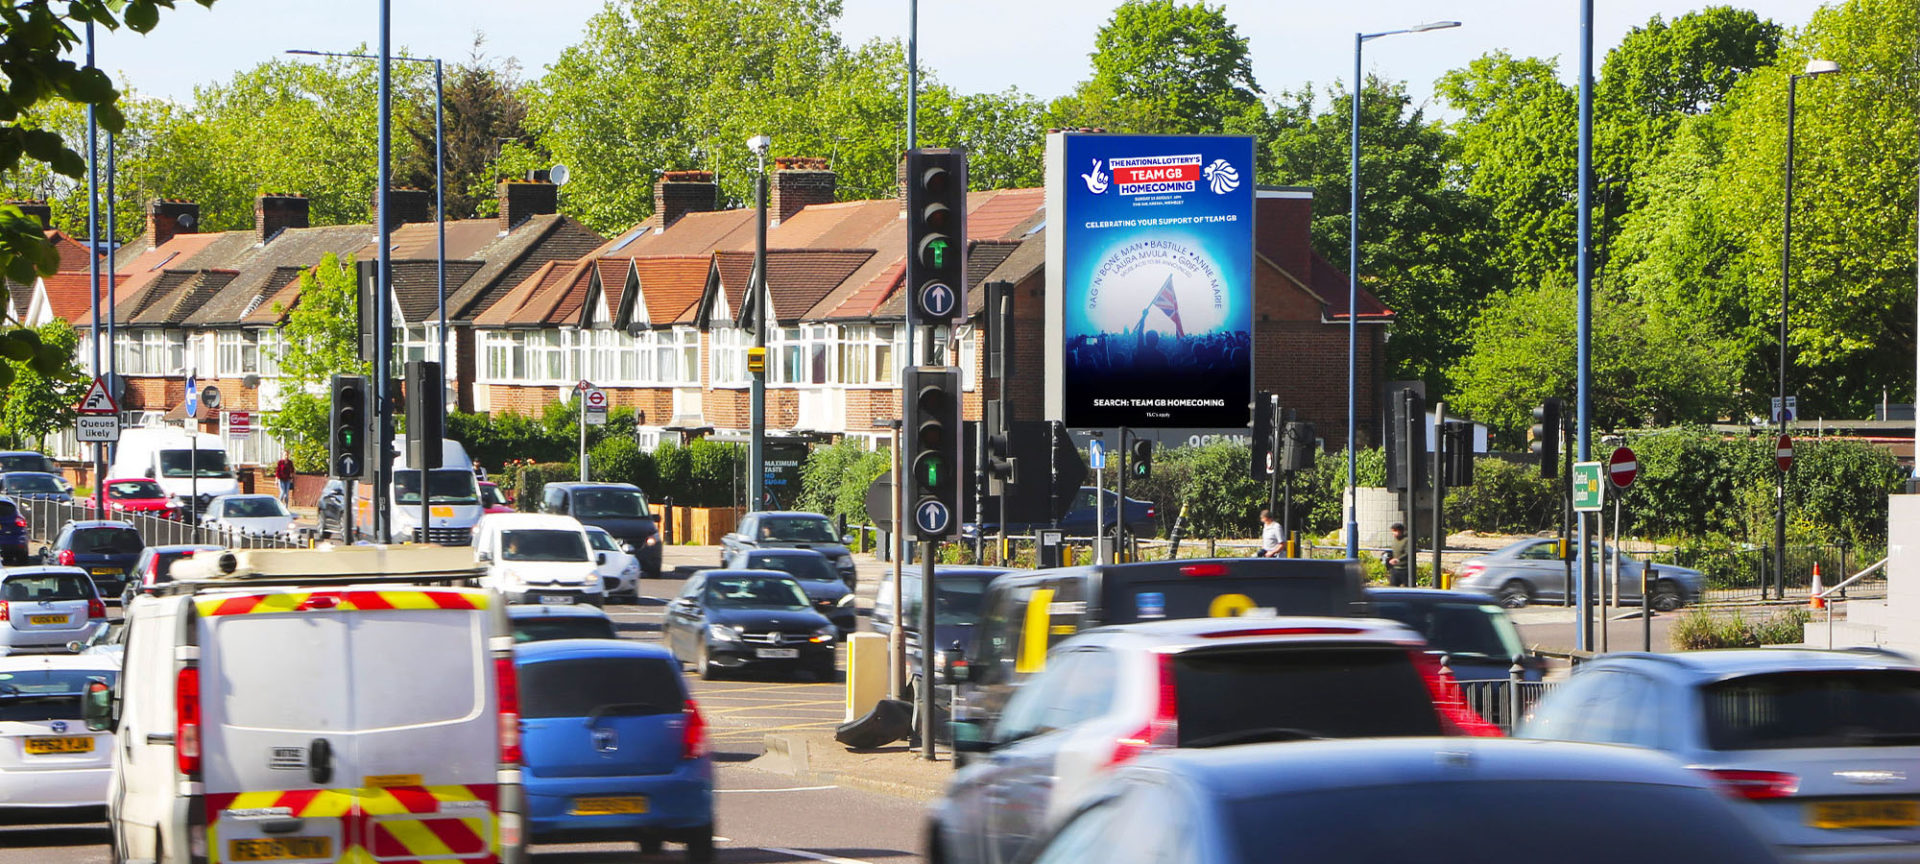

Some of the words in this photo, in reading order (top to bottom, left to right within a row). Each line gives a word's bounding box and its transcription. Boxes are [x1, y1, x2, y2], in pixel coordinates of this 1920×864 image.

[1126, 158, 1161, 166] NATIONAL
[1162, 156, 1200, 164] LOTTERY'S
[1130, 169, 1164, 181] TEAM
[1166, 168, 1182, 179] GB
[1121, 181, 1193, 193] HOMECOMING
[1085, 219, 1136, 228] CELEBRATING
[1158, 217, 1192, 225] SUPPORT
[1205, 215, 1225, 223] TEAM
[1112, 254, 1137, 274] LAURA
[1138, 250, 1167, 258] MVULA
[1178, 256, 1199, 273] GRIFF
[1120, 243, 1143, 256] MAN
[1150, 241, 1188, 255] BASTILLE
[1193, 255, 1214, 278] ANNE
[1210, 278, 1222, 309] MARIE
[1093, 399, 1129, 407] SEARCH:
[1130, 399, 1154, 407] TEAM
[1154, 399, 1166, 407] GB
[1167, 399, 1224, 407] HOMECOMING
[81, 419, 115, 428] Queues
[85, 429, 110, 438] likely
